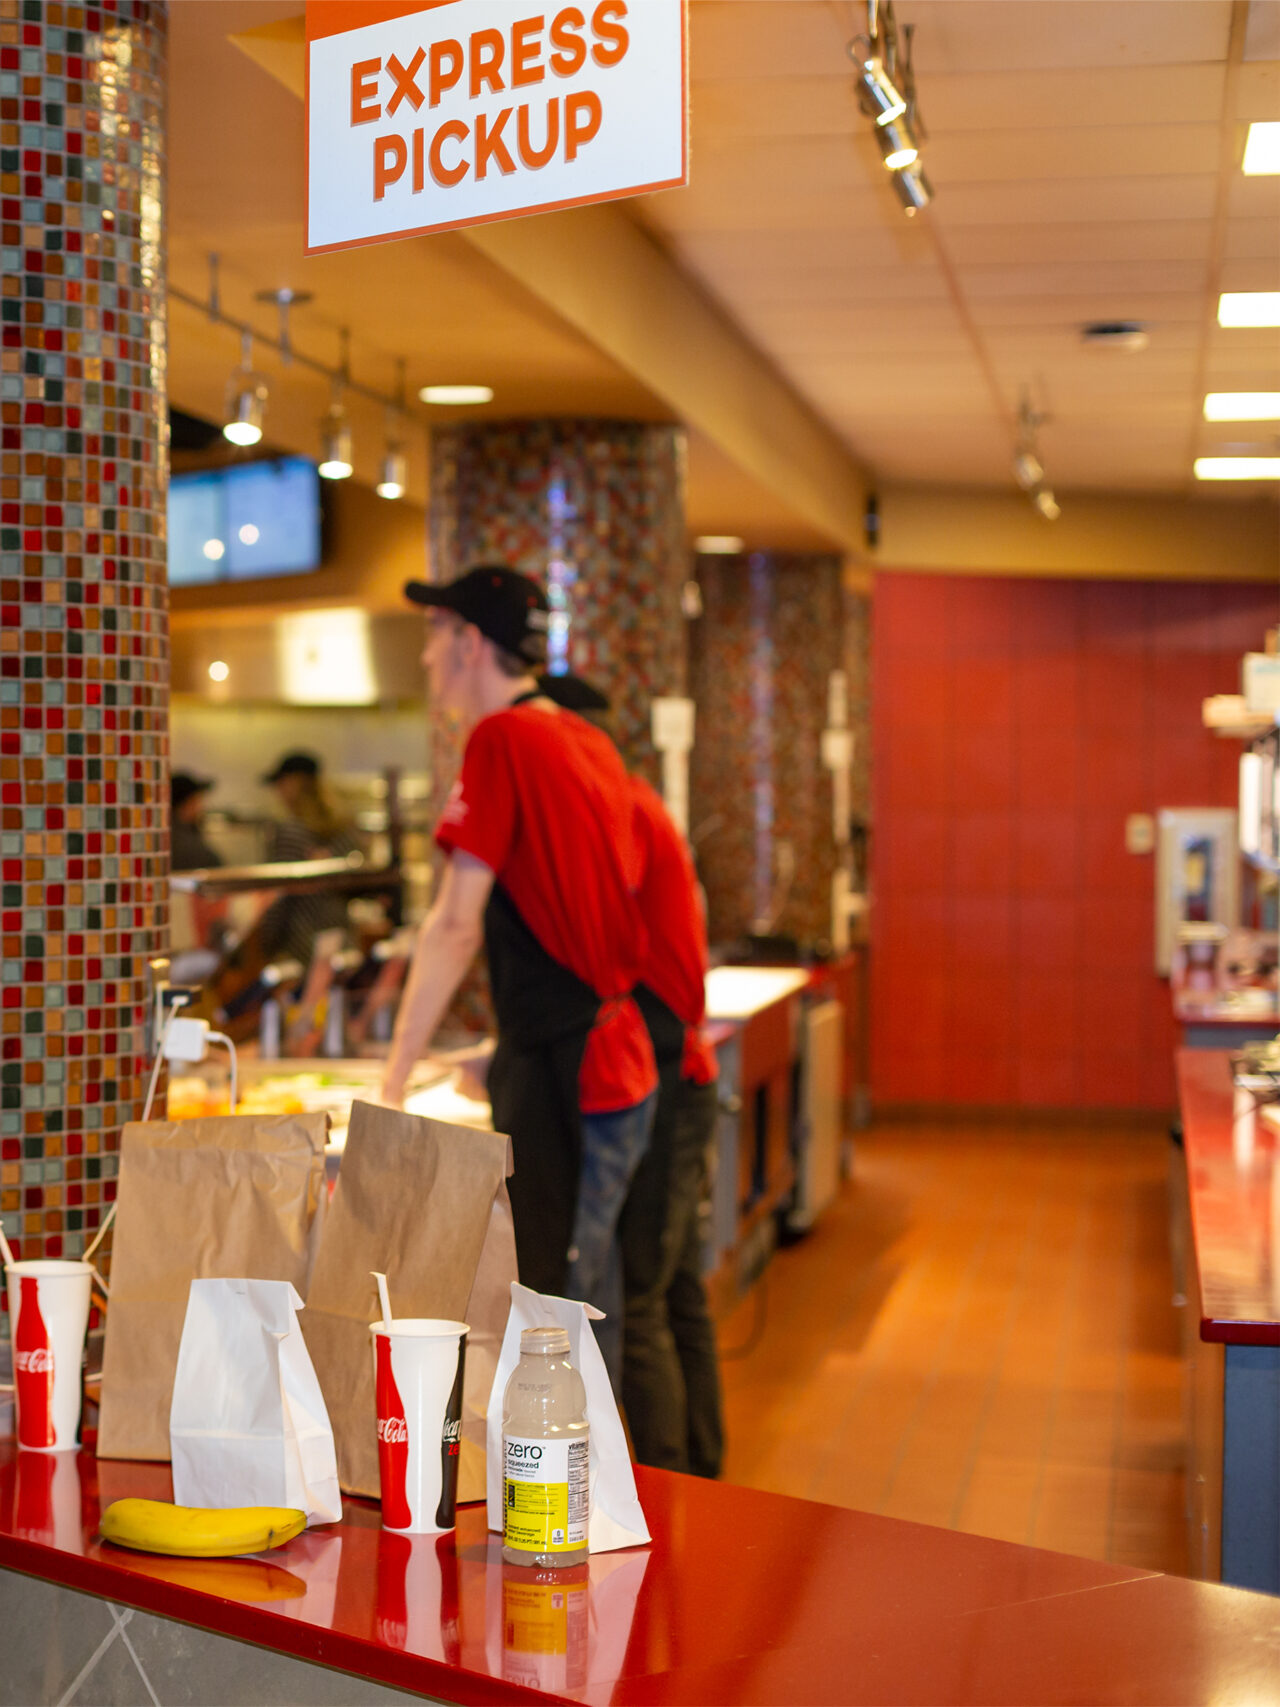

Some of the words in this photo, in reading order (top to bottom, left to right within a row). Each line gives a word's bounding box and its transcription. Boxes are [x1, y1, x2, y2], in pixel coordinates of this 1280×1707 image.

[351, 0, 630, 127] EXPRESS
[373, 90, 603, 202] PICKUP
[507, 1442, 543, 1460] zero
